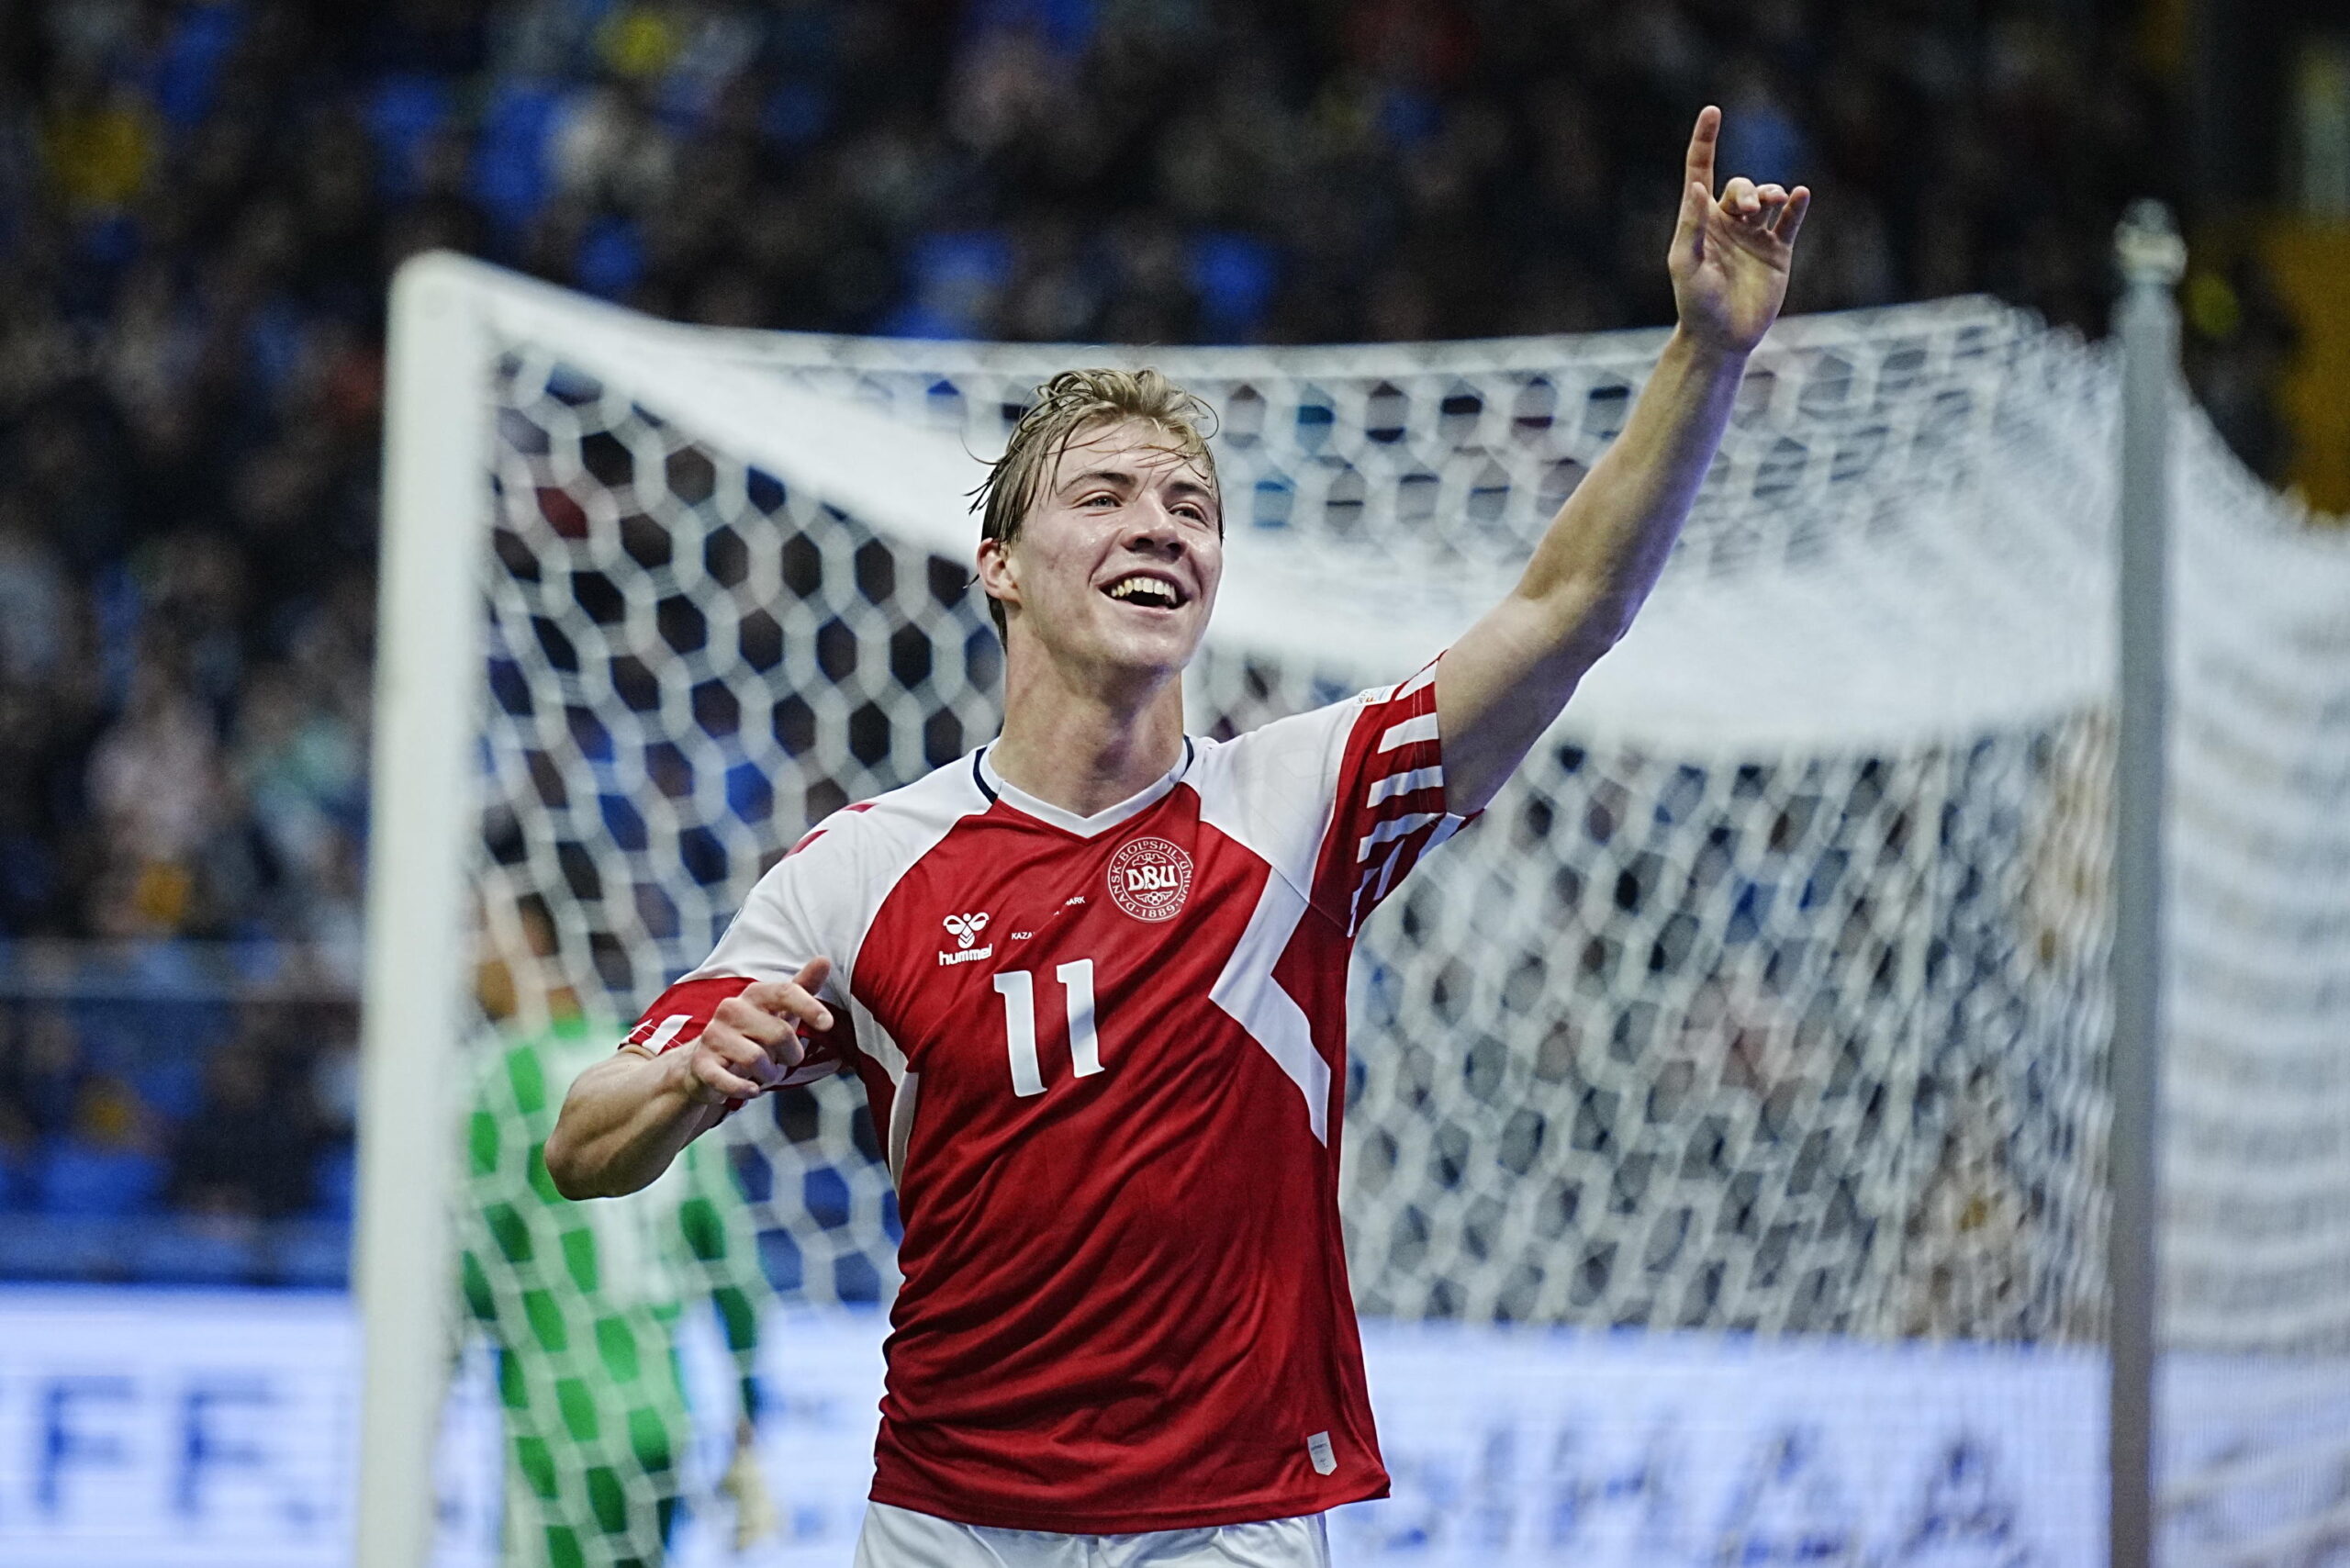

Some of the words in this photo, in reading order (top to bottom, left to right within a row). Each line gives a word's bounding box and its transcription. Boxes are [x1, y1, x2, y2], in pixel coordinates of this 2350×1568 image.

[1111, 865, 1136, 912] DANSK
[1125, 865, 1179, 891] DBU
[1011, 931, 1035, 941] KAZA
[938, 943, 993, 967] hummel
[993, 958, 1105, 1098] 11
